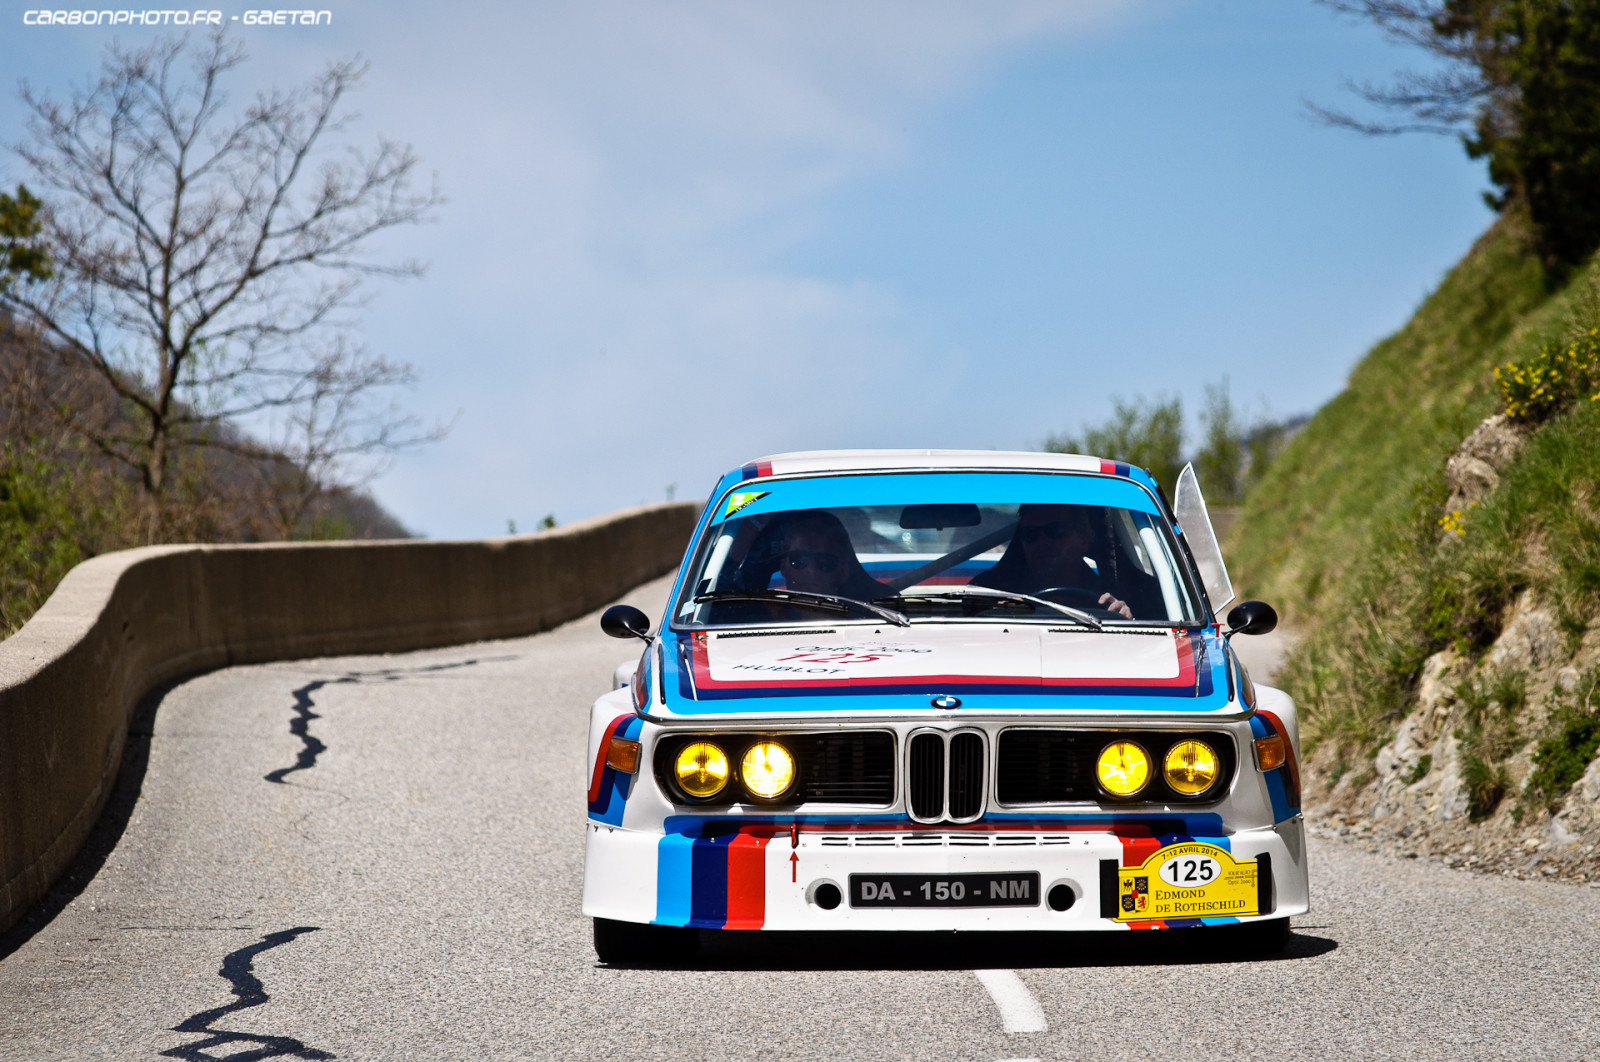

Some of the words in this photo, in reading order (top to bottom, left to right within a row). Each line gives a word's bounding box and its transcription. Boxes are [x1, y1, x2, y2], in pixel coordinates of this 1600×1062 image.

[777, 653, 894, 664] 125
[732, 664, 846, 675] HUBLOT
[1161, 849, 1178, 860] 7-12
[1179, 846, 1200, 855] AVRIL
[1201, 847, 1218, 857] 2014
[1168, 859, 1213, 882] 125
[861, 881, 896, 900] DA
[920, 881, 966, 900] 150
[989, 880, 1030, 899] NM
[1174, 900, 1246, 913] ROTHSCHILD
